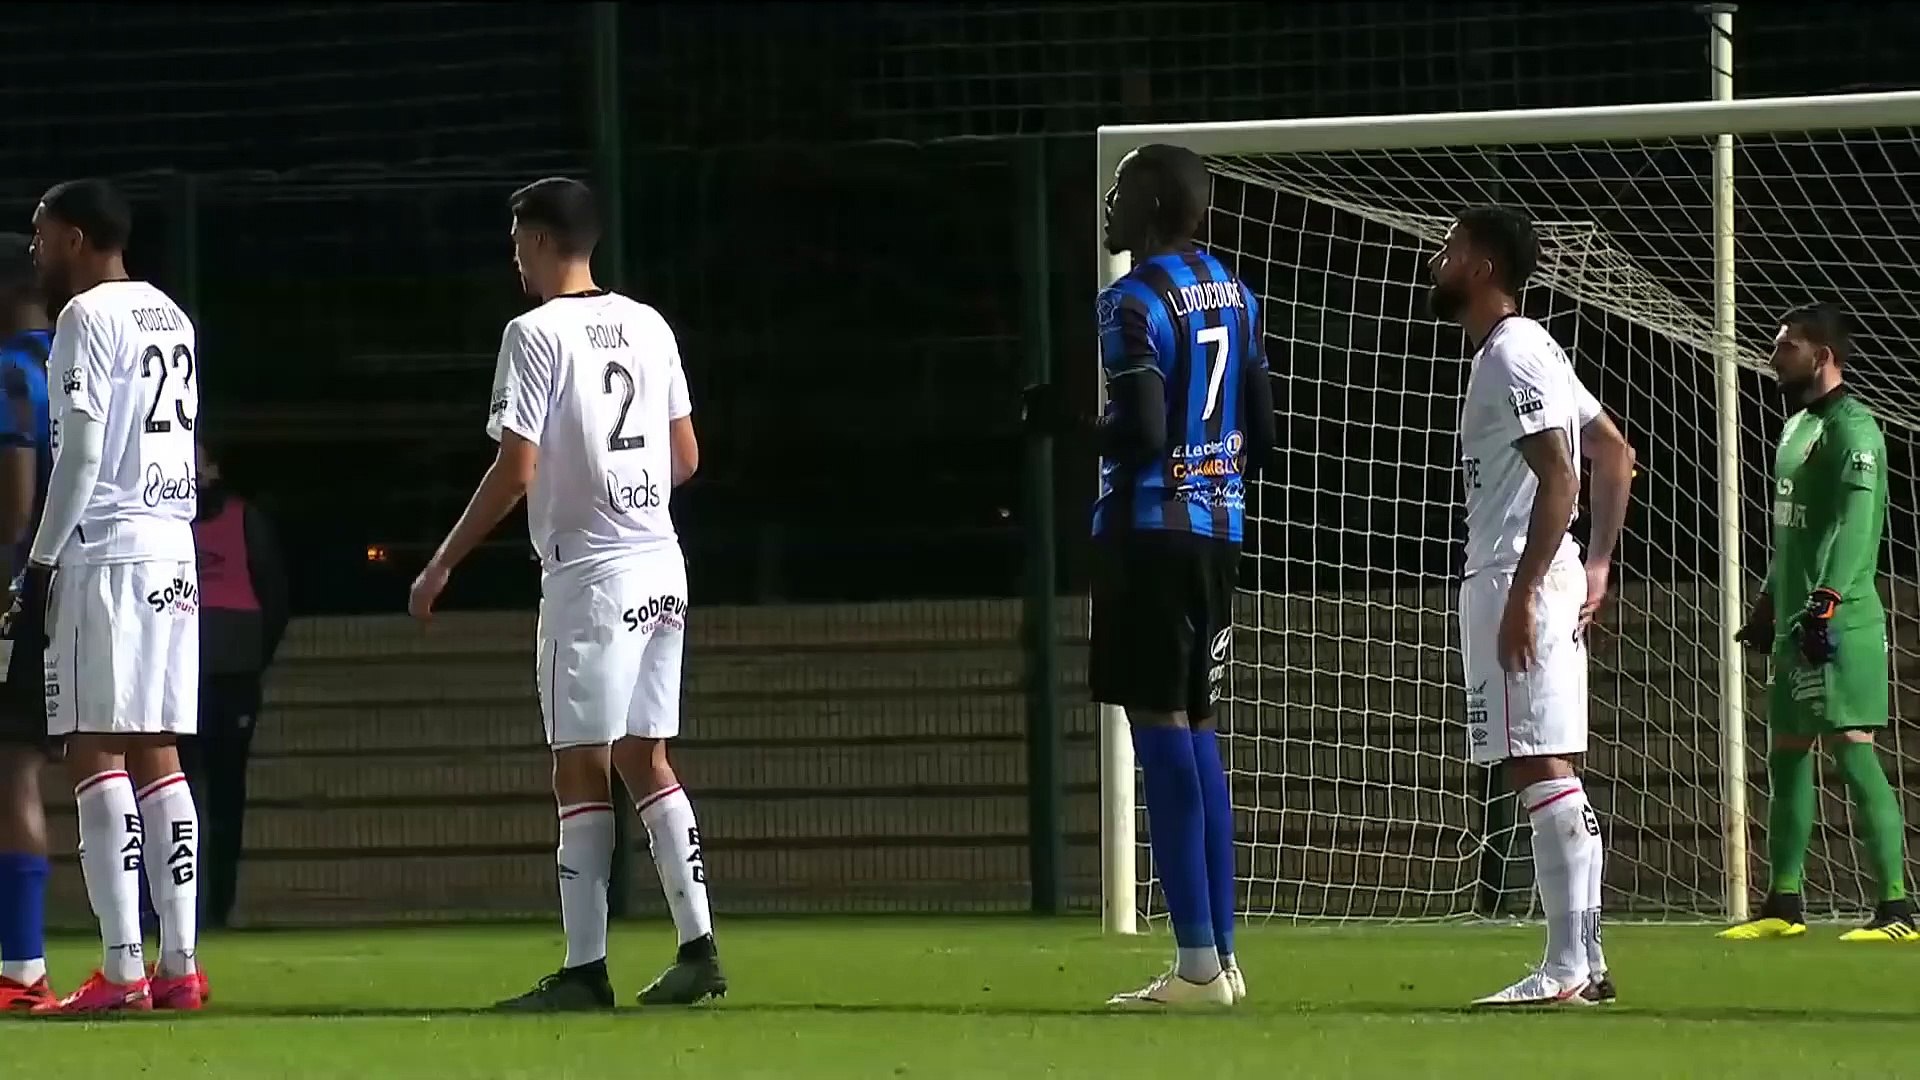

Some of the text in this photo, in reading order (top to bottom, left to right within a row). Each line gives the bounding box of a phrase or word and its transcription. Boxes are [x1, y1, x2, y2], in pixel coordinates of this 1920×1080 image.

[585, 323, 629, 348] ROUX
[1196, 325, 1229, 422] 7
[140, 344, 194, 433] 23
[602, 361, 645, 451] 2
[120, 814, 142, 872] EAG
[168, 821, 194, 886] EAG
